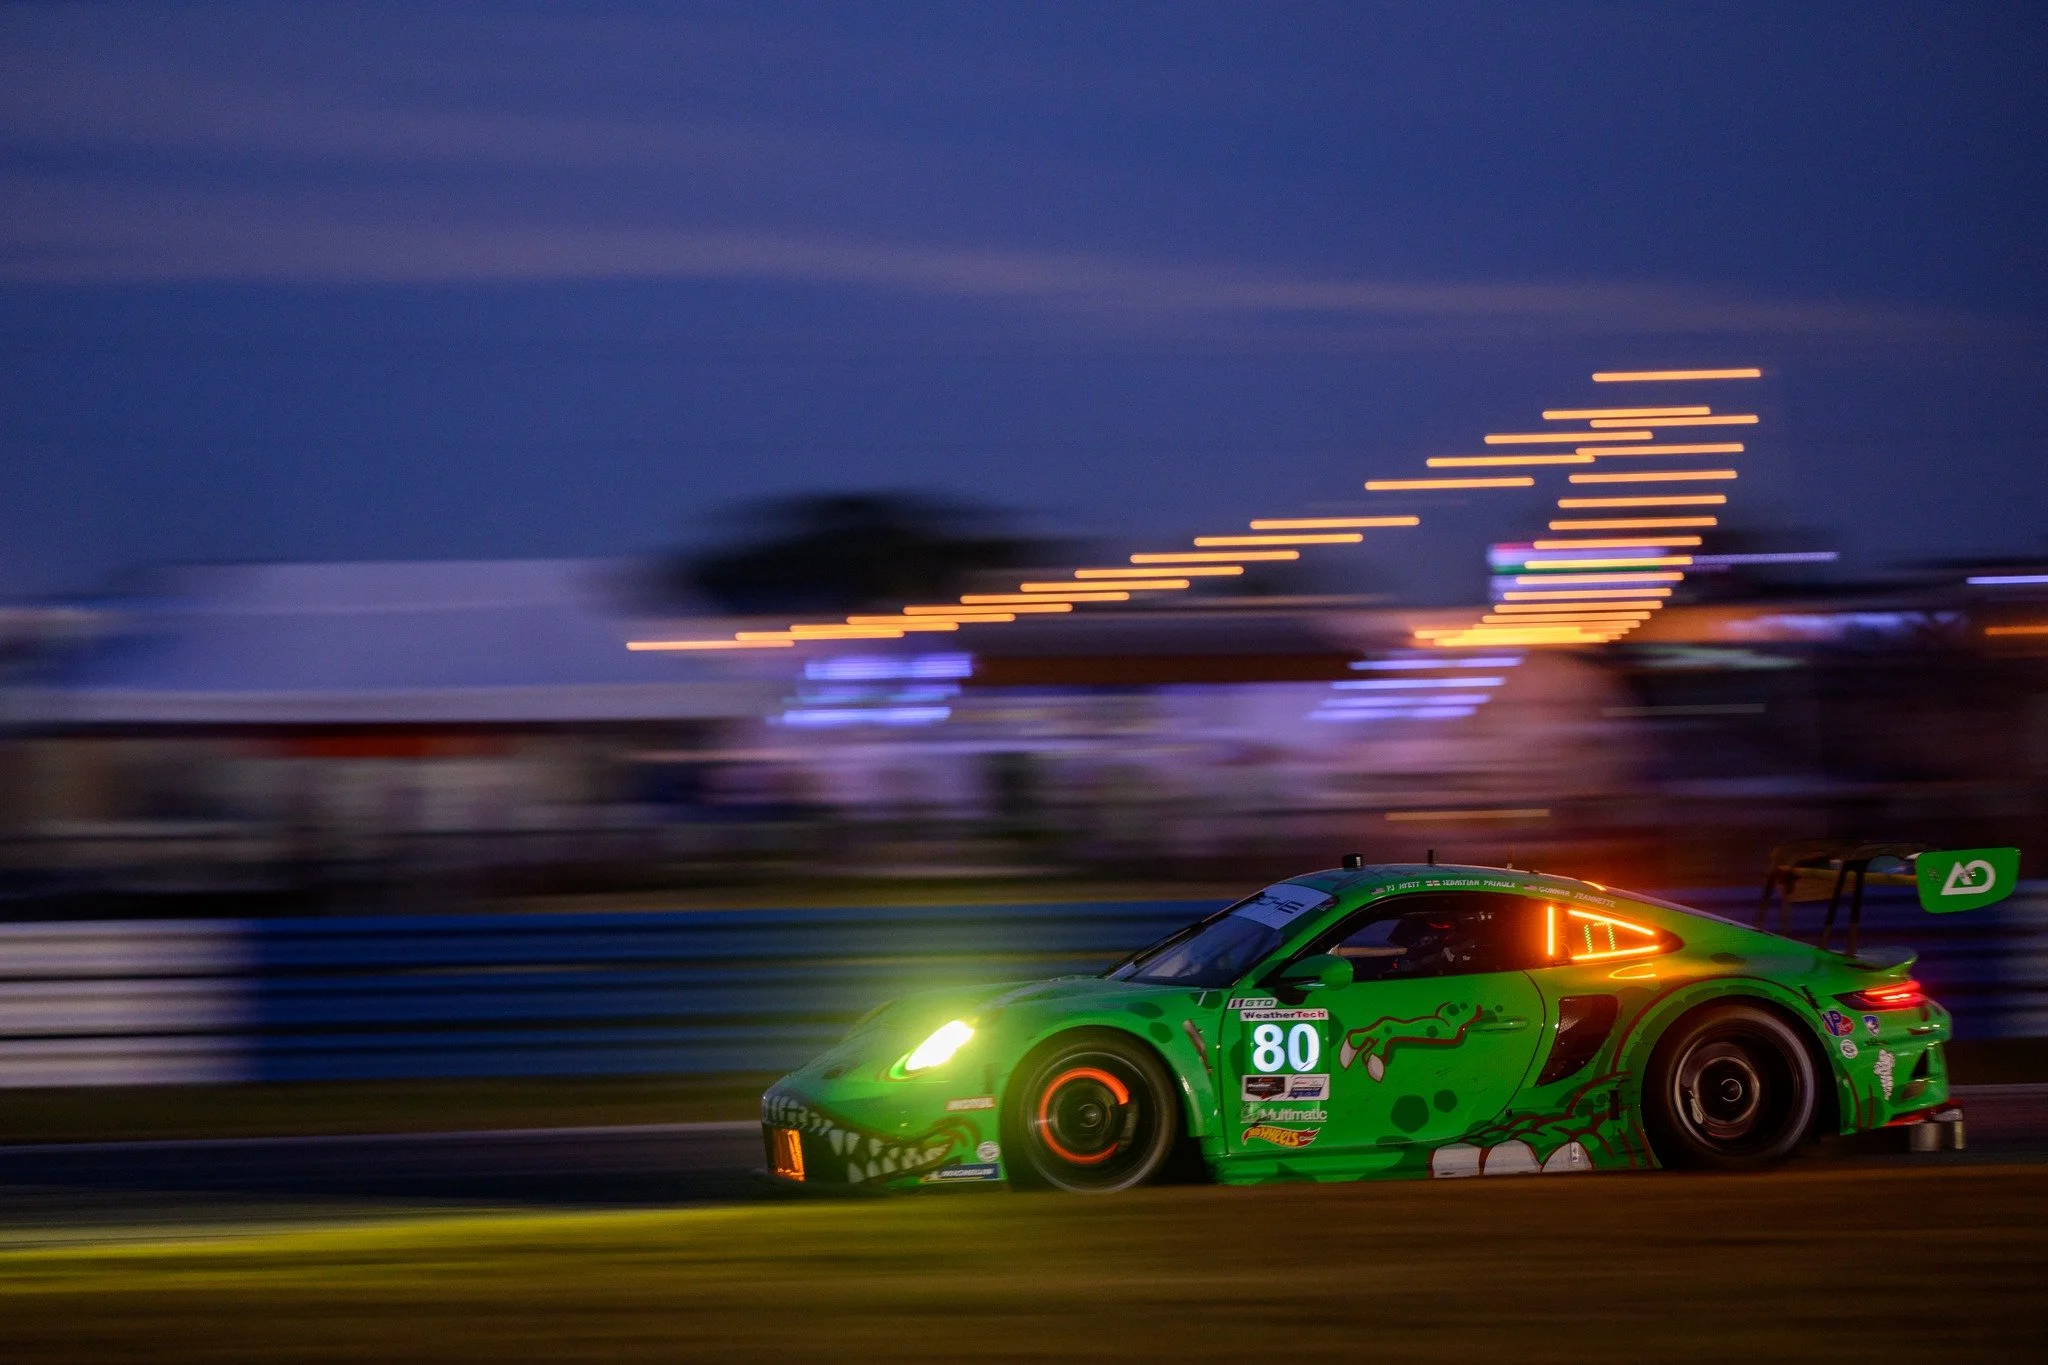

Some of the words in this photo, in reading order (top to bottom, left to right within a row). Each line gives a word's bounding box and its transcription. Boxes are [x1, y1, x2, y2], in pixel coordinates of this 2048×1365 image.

[1386, 884, 1395, 892] PJ
[1399, 881, 1420, 890] HYETT
[1442, 879, 1480, 887] SEBASTIAN
[1483, 880, 1516, 889] PRIAULX
[1538, 886, 1571, 897] GUNNAR
[1574, 892, 1616, 908] JEANNETTE
[1245, 999, 1274, 1007] GTD
[1243, 1010, 1325, 1019] WeatherTech
[1252, 1023, 1320, 1073] 80
[1259, 1107, 1329, 1121] Multimatic
